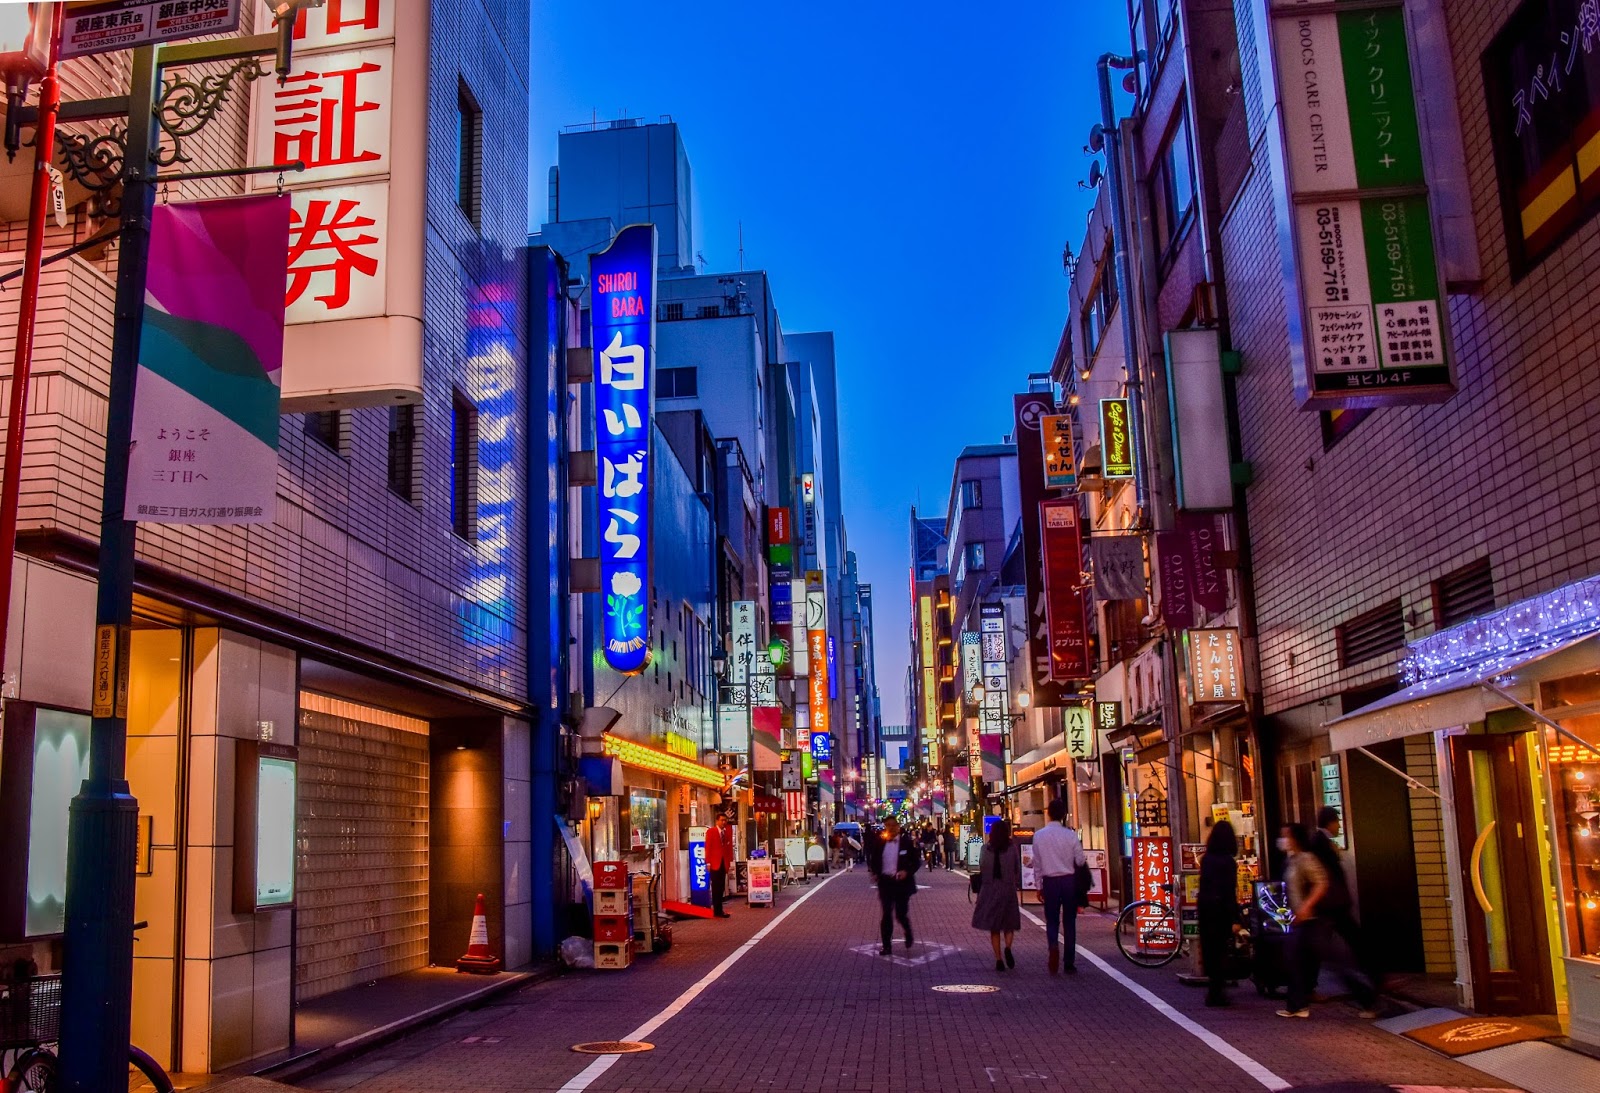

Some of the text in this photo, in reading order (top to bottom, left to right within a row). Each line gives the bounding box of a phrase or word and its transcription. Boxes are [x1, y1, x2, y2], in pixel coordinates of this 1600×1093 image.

[159, 0, 229, 19] 銀座中央店
[75, 11, 143, 33] 銀座東京店
[1299, 20, 1328, 173] BOOCS CARE CENTER
[1316, 208, 1340, 302] 03-5159-7161
[598, 272, 637, 294] SHIROI
[612, 297, 644, 318] BARA
[1322, 333, 1364, 343] ボディケア
[1323, 344, 1366, 354] ヘッドケア
[1347, 371, 1411, 386] 当ビル4F
[156, 428, 211, 441] ようこそ
[600, 331, 647, 559] 白いばら
[168, 449, 196, 462] 銀座
[1111, 433, 1123, 463] Dining
[137, 504, 264, 518] 銀座三丁目ガス灯通り振興会
[1048, 520, 1073, 528] TABLIER
[1172, 555, 1186, 613] NAGAO
[1055, 638, 1082, 647] タブリエ
[100, 629, 111, 702] 銀座ガス灯通り
[1208, 633, 1224, 698] たんす屋
[1069, 713, 1085, 753] ハゲ天
